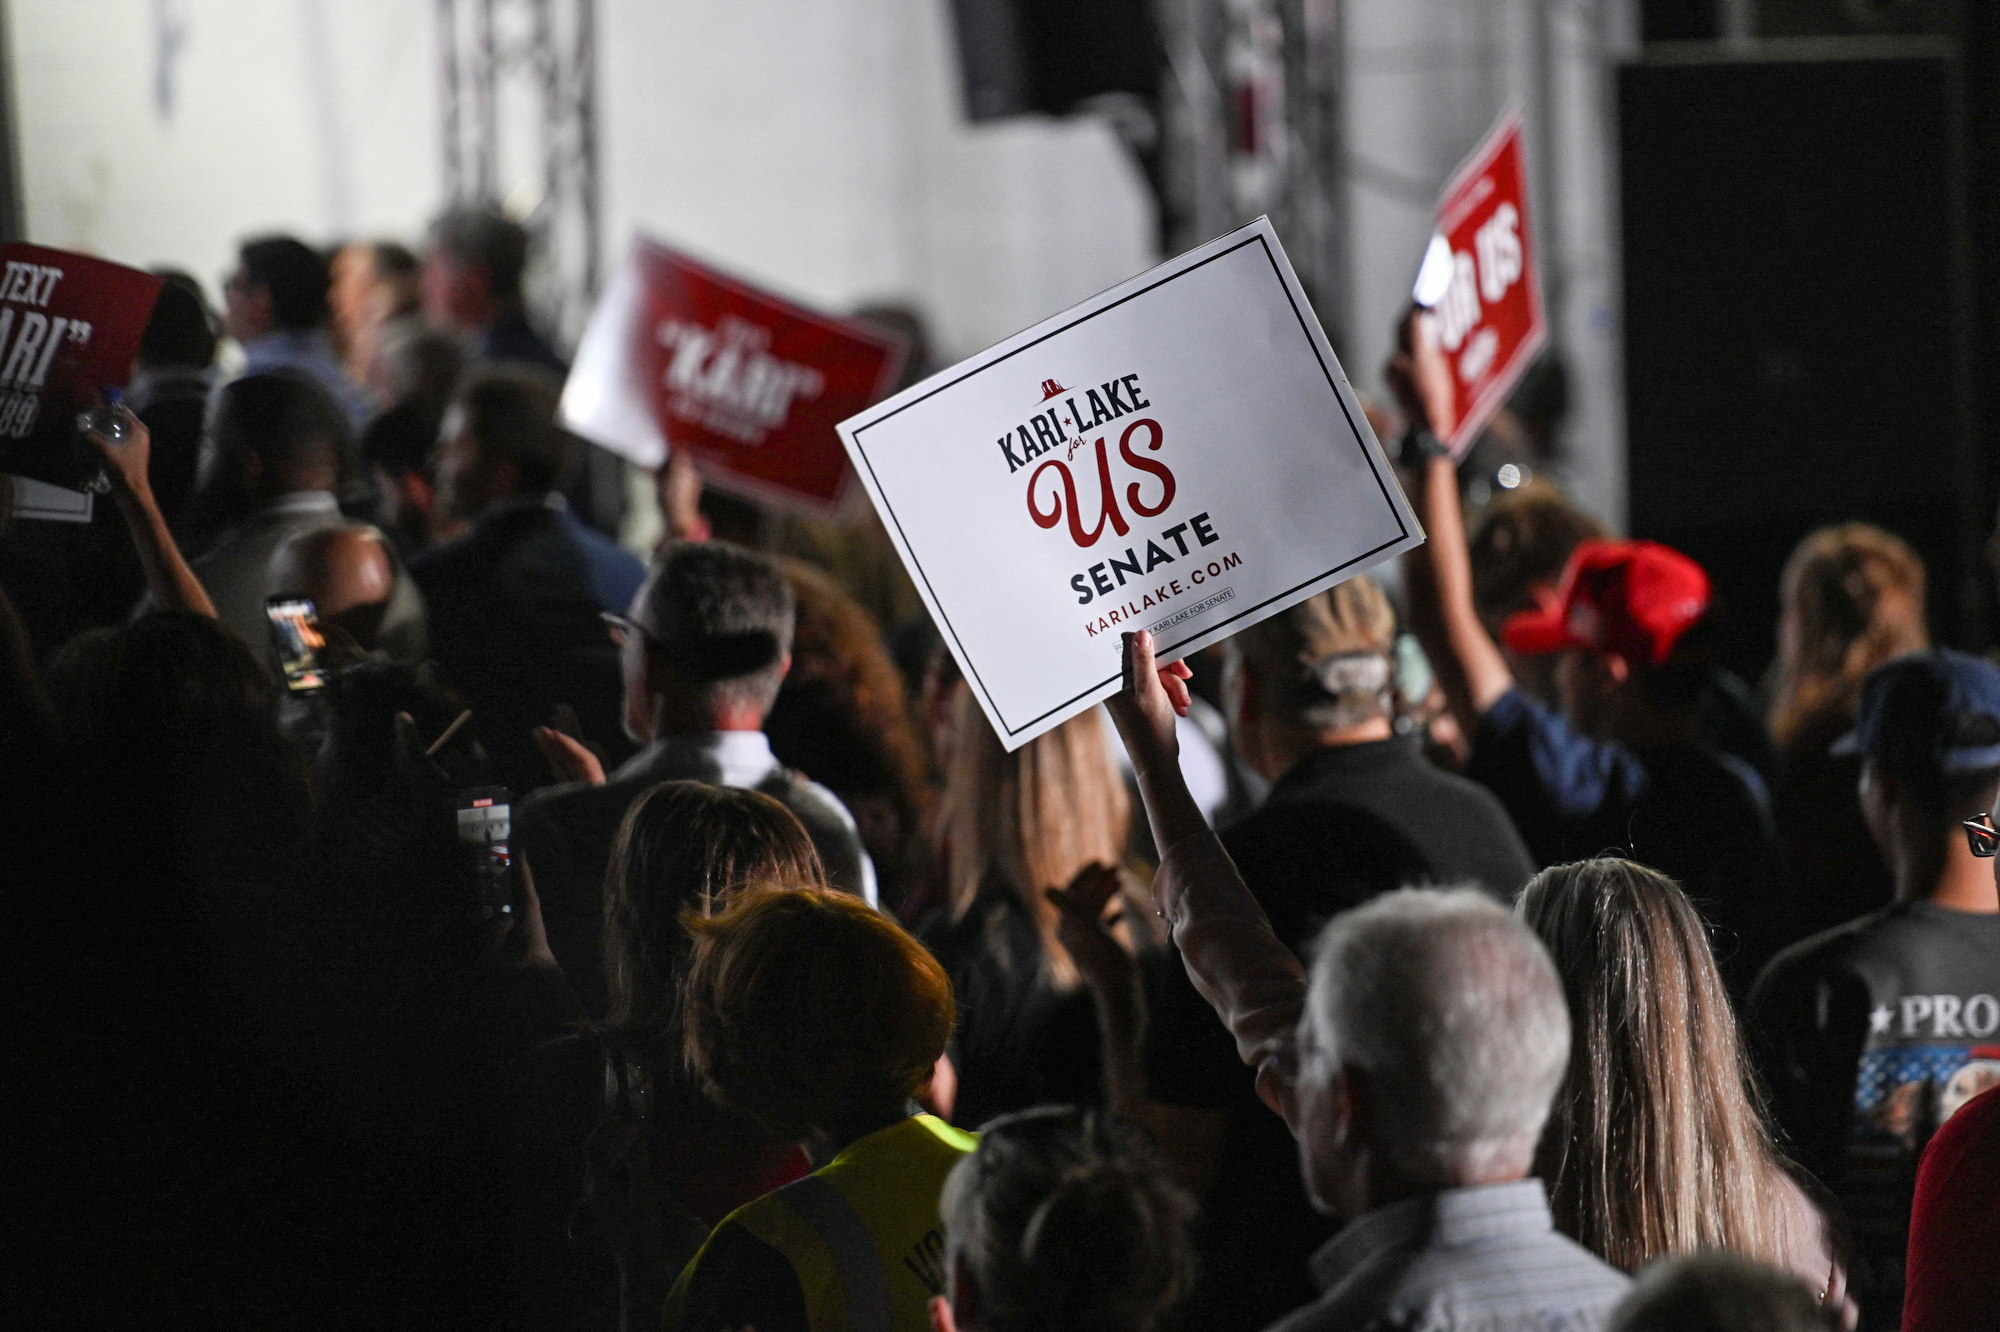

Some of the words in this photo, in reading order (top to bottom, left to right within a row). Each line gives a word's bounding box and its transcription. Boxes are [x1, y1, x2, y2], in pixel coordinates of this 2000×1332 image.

[0, 260, 64, 307] TEXT
[997, 407, 1068, 473] KARI
[1065, 373, 1151, 434] LAKE
[1067, 435, 1087, 461] for
[1027, 418, 1176, 548] US
[1070, 512, 1220, 605] SENATE
[1085, 552, 1243, 637] KARILAKE.COM
[1153, 620, 1171, 633] KARI
[1170, 612, 1189, 625] LAKE
[1189, 603, 1206, 616] FOR
[1205, 590, 1233, 607] SENATE
[1901, 993, 2000, 1038] PRO
